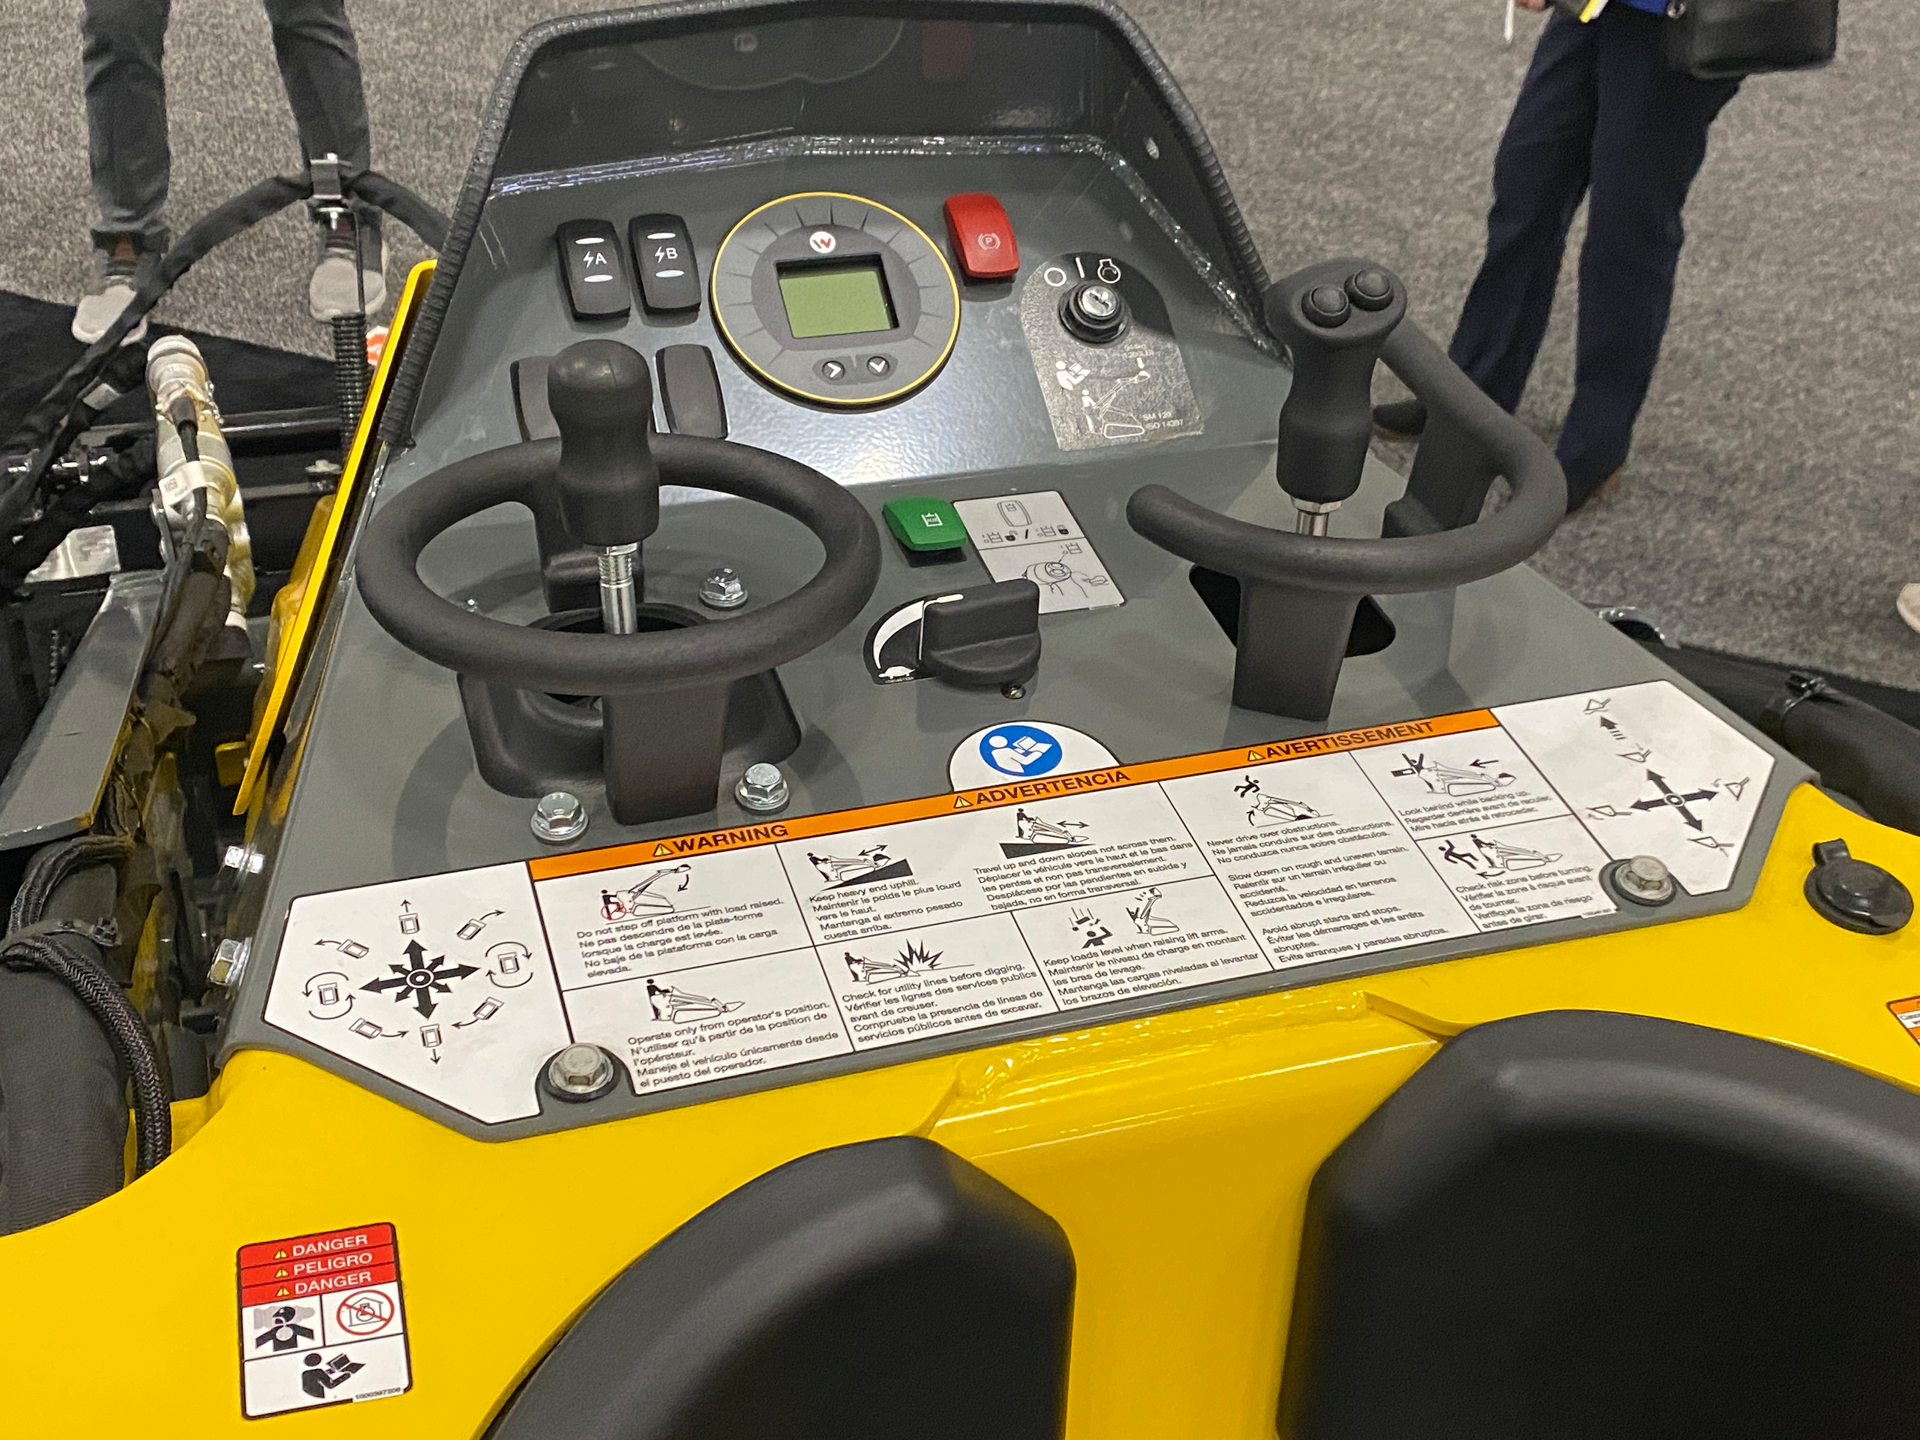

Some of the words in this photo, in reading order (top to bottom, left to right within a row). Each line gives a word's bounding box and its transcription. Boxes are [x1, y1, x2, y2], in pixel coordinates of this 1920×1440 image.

[595, 252, 607, 265] A
[666, 247, 678, 259] B
[1265, 721, 1433, 759] AVERTISSEMENT
[975, 770, 1130, 805] ADVERTENCIA
[672, 824, 788, 853] WARNING
[972, 864, 1002, 874] Travel
[1017, 858, 1037, 867] and
[1038, 854, 1065, 864] down
[1066, 849, 1098, 859] slopes
[1116, 840, 1148, 850] across
[1149, 836, 1176, 844] them.
[808, 894, 835, 903] Keep
[836, 888, 866, 898] heavy
[868, 883, 888, 893] end
[889, 878, 920, 891] uphill.
[576, 931, 593, 939] Do
[594, 926, 613, 936] not
[614, 923, 638, 932] step
[640, 919, 653, 928] off
[656, 913, 699, 927] platform
[700, 908, 723, 917] with
[724, 903, 747, 913] load
[749, 897, 784, 909] raised.
[578, 940, 595, 948] Ne
[596, 937, 617, 947] pas
[619, 927, 675, 941] descendre
[704, 912, 764, 928] plate-forme
[581, 946, 622, 958] lorsque
[635, 937, 672, 949] charge
[674, 933, 691, 942] est
[584, 960, 601, 968] No
[602, 955, 626, 965] baje
[628, 952, 643, 960] de
[656, 940, 713, 956] plataforma
[714, 936, 735, 945] con
[748, 929, 778, 939] carga
[1042, 957, 1070, 967] Keep
[1070, 951, 1099, 962] loads
[1099, 945, 1123, 956] level
[1124, 942, 1152, 951] when
[1152, 935, 1186, 946] raising
[1185, 932, 1199, 940] lift
[1200, 928, 1228, 938] arms.
[1047, 962, 1094, 976] Maintenir
[1107, 954, 1140, 965] niveau
[1156, 945, 1190, 956] charge
[1205, 934, 1246, 947] montant
[587, 965, 631, 978] elevada.
[841, 990, 876, 1002] Check
[877, 987, 892, 996] for
[894, 982, 921, 993] utility
[922, 977, 948, 987] lines
[949, 971, 982, 982] before
[984, 963, 1025, 976] digging.
[883, 997, 900, 1005] les
[900, 991, 933, 1002] lignes
[934, 987, 954, 995] des
[955, 978, 998, 991] services
[999, 971, 1037, 985] publics
[1052, 978, 1068, 986] les
[1069, 973, 1093, 983] bras
[1094, 970, 1108, 978] de
[1108, 964, 1145, 975] levage.
[1057, 981, 1109, 996] Mantenga
[1126, 971, 1161, 982] cargas
[1162, 962, 1209, 976] niveladas
[1210, 959, 1219, 967] al
[1219, 952, 1258, 965] levantar
[849, 1011, 879, 1023] avant
[880, 1008, 895, 1016] de
[896, 1000, 938, 1013] creuser.
[1061, 997, 1079, 1005] los
[1079, 990, 1115, 1002] brazos
[627, 1031, 672, 1045] Operate
[674, 1026, 697, 1036] only
[699, 1021, 725, 1031] from
[727, 1010, 782, 1026] operator's
[784, 1002, 830, 1017] position.
[853, 1015, 916, 1032] Compruebe
[929, 1002, 980, 1019] presencia
[981, 999, 996, 1007] de
[857, 1028, 905, 1042] servicios
[953, 1013, 983, 1024] antes
[984, 1009, 998, 1017] de
[1000, 1002, 1042, 1014] excavar.
[630, 1040, 679, 1056] N'utiliser
[708, 1029, 737, 1042] partir
[739, 1026, 754, 1035] de
[754, 1024, 766, 1032] la
[767, 1015, 811, 1031] position
[813, 1012, 827, 1020] de
[636, 1063, 678, 1077] Maneje
[679, 1059, 690, 1068] el
[804, 1032, 838, 1044] desde
[639, 1078, 650, 1087] el
[652, 1072, 691, 1087] puesto
[693, 1066, 711, 1077] del
[713, 1057, 766, 1073] operador.
[292, 1234, 368, 1256] DANGER
[294, 1252, 373, 1276] PELIGRO
[295, 1272, 371, 1294] DANGER
